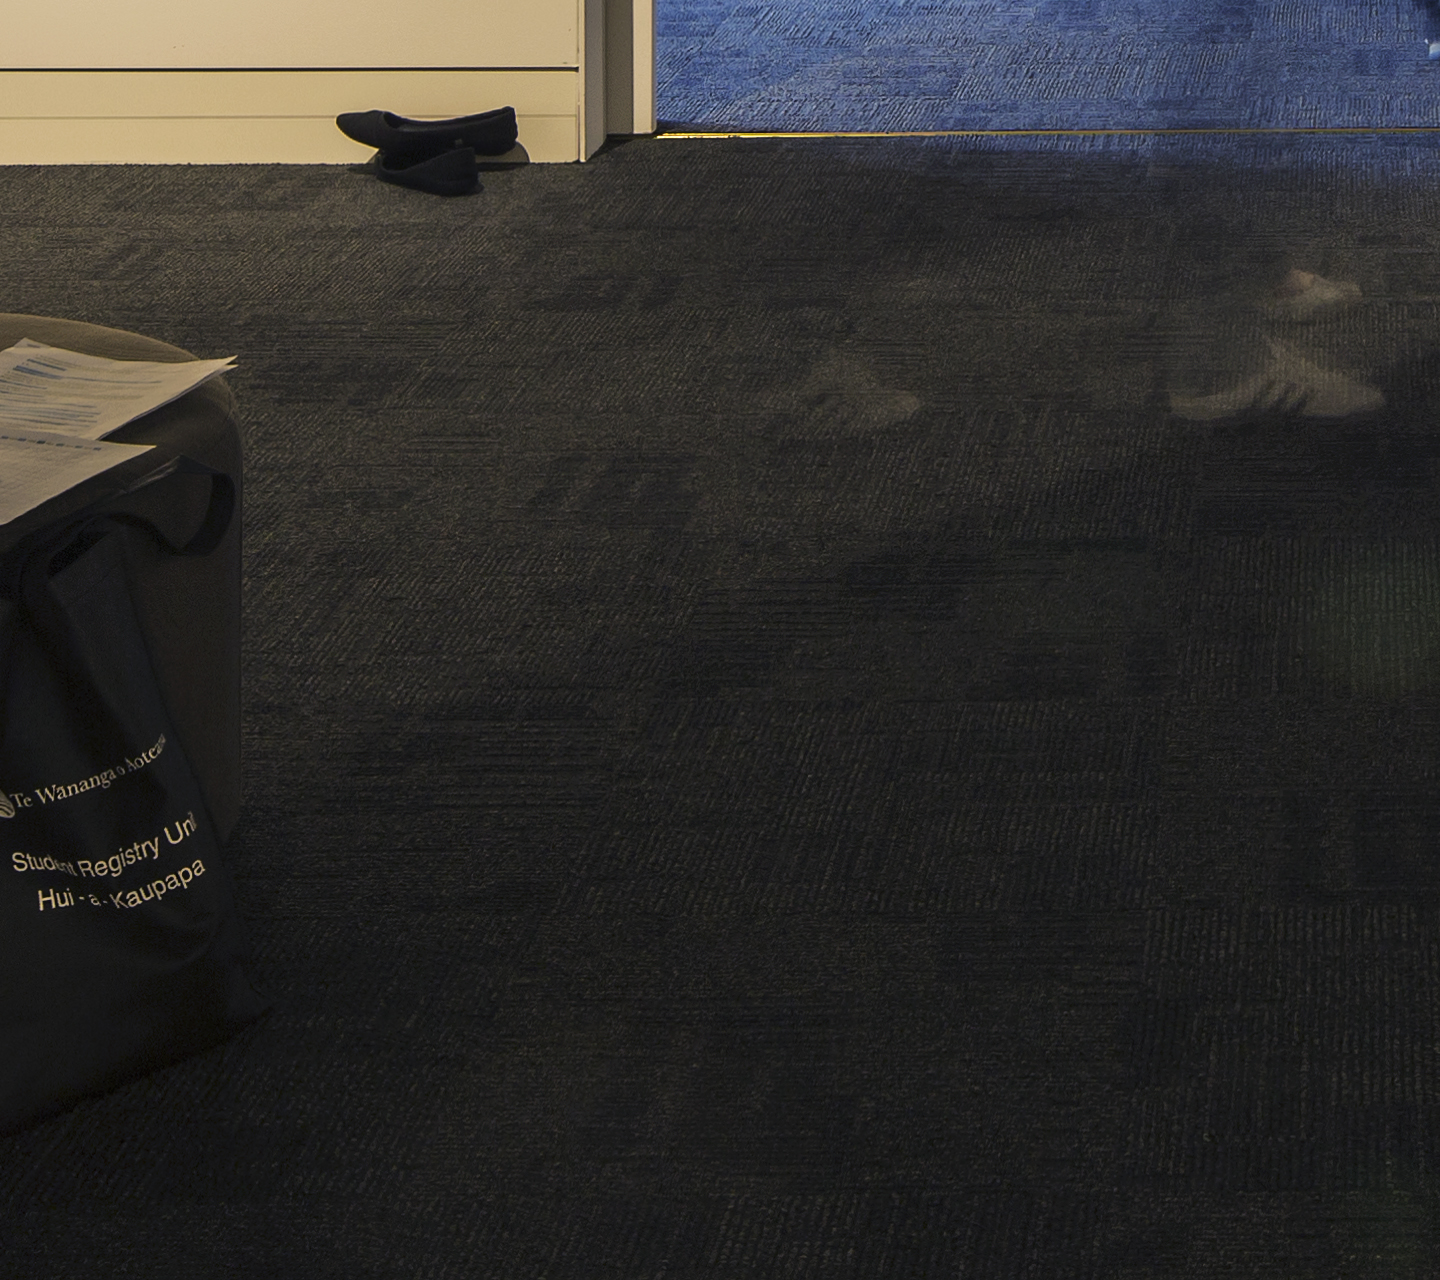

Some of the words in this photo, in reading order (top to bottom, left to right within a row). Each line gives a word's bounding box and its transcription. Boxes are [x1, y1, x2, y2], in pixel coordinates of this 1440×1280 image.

[10, 793, 33, 808] Te
[12, 852, 78, 877] Student
[77, 837, 159, 878] Registry
[38, 887, 75, 911] Hui
[109, 859, 206, 909] Kaupapa
